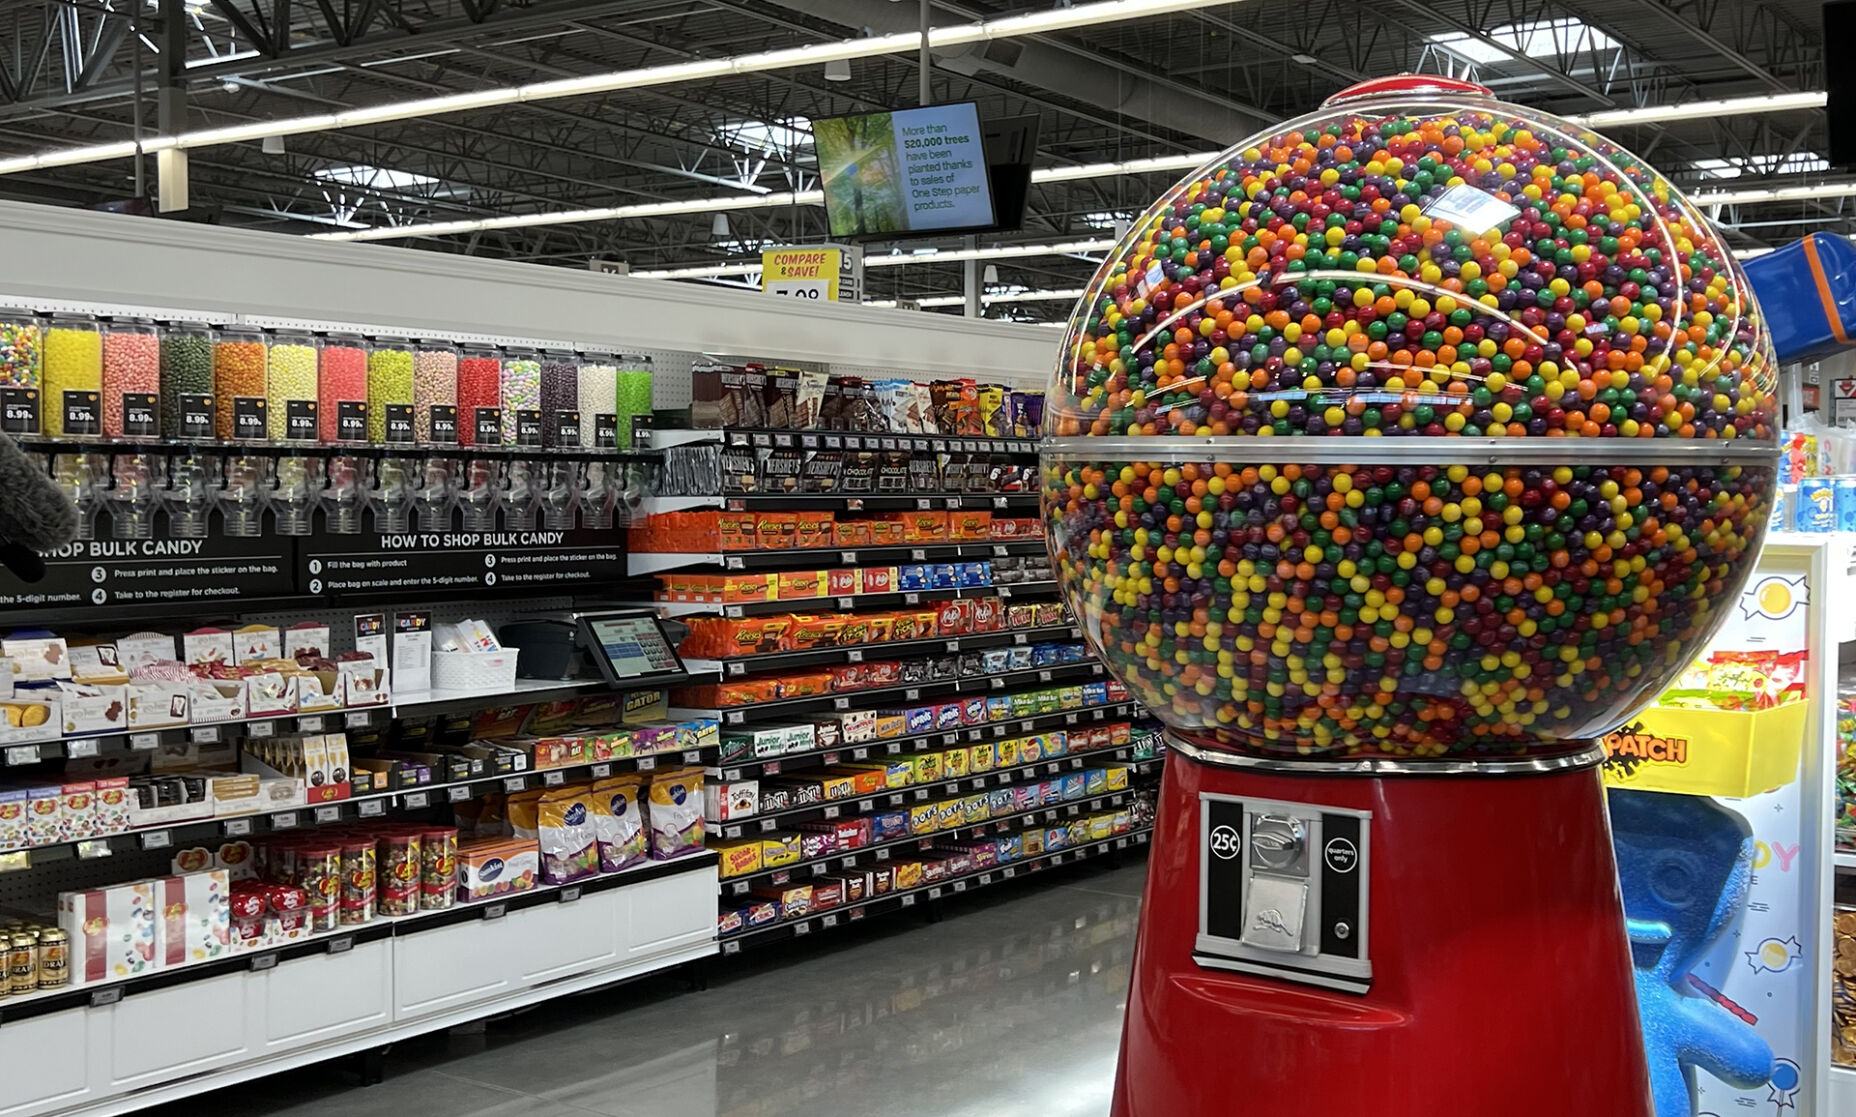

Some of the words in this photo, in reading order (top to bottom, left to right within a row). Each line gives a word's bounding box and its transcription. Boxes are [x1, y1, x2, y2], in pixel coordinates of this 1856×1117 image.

[902, 127, 925, 136] More
[926, 124, 947, 134] than
[944, 135, 970, 144] trees
[906, 151, 928, 161] have
[929, 149, 952, 159] been
[908, 162, 941, 175] planted
[942, 159, 973, 170] thanks
[910, 178, 919, 186] to
[921, 176, 944, 185] sales
[946, 172, 955, 183] of
[912, 188, 930, 198] One
[932, 186, 952, 198] Step
[954, 185, 980, 197] paper
[913, 200, 955, 212] products.
[774, 253, 827, 265] COMPARE
[781, 266, 786, 275] &
[787, 266, 819, 277] SAVE!
[382, 535, 417, 548] HOW
[421, 534, 440, 547] TO
[443, 533, 480, 547] SHOP
[484, 532, 517, 546] BULK
[520, 532, 564, 545] CANDY
[90, 541, 137, 556] BULK
[142, 540, 203, 555] CANDY
[352, 561, 365, 569] bag
[382, 560, 407, 568] product
[517, 556, 531, 564] print
[544, 555, 558, 563] place
[114, 569, 136, 578] Press
[137, 568, 157, 578] print
[158, 568, 173, 576] and
[175, 567, 195, 577] place
[212, 566, 236, 574] sticker
[262, 565, 278, 574] bag.
[348, 580, 361, 589] bag
[433, 576, 453, 585] 5-digit
[114, 591, 134, 599] Take
[160, 588, 190, 598] register
[204, 587, 240, 595] checkout.
[0, 596, 14, 604] the
[16, 595, 45, 603] 5-digit
[400, 618, 426, 628] CANDY
[626, 691, 660, 712] GATOR
[757, 736, 780, 747] Junior
[1604, 733, 1687, 763] PATCH
[939, 798, 964, 820] DOTS
[912, 804, 938, 827] DOTS
[1213, 833, 1237, 852] 25¢
[1328, 847, 1354, 856] quarters
[1334, 854, 1348, 863] only
